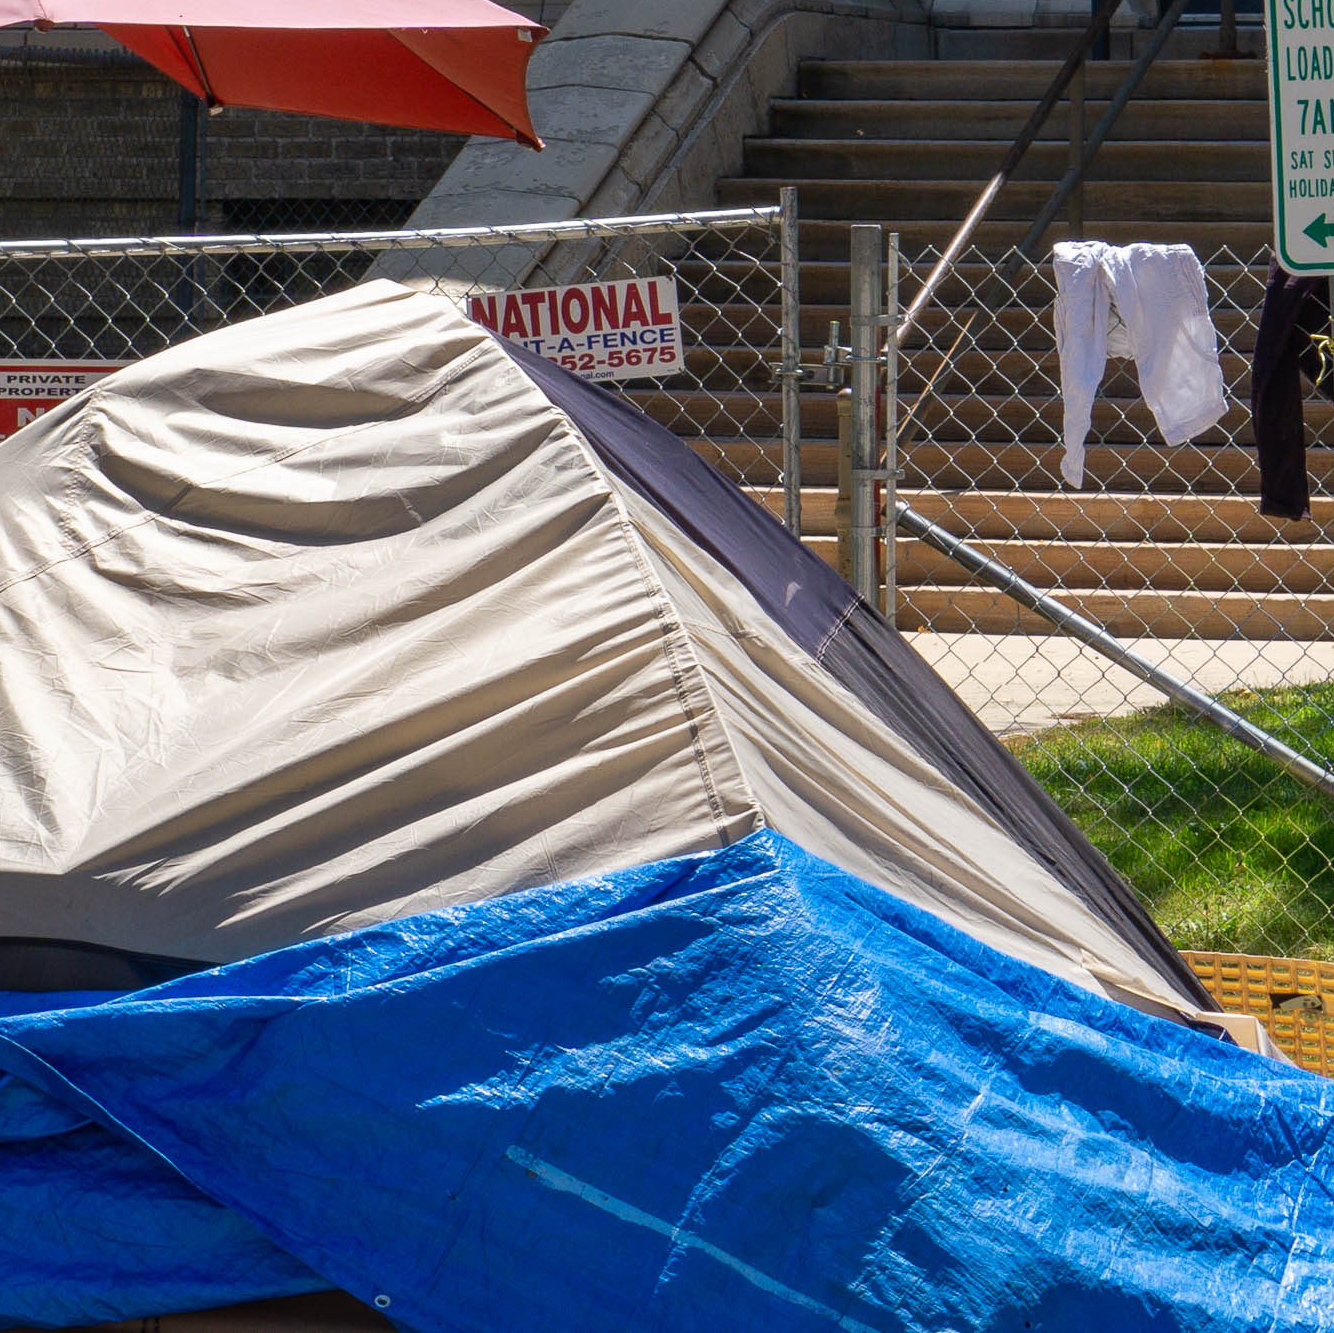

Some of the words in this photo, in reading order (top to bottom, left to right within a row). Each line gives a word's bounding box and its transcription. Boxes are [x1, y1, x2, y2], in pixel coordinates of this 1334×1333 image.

[1290, 150, 1314, 170] SAT
[471, 280, 673, 340] NATIONAL
[523, 327, 676, 354] T-A-FENCE
[6, 375, 86, 384] PRIVATE
[17, 407, 46, 427] N
